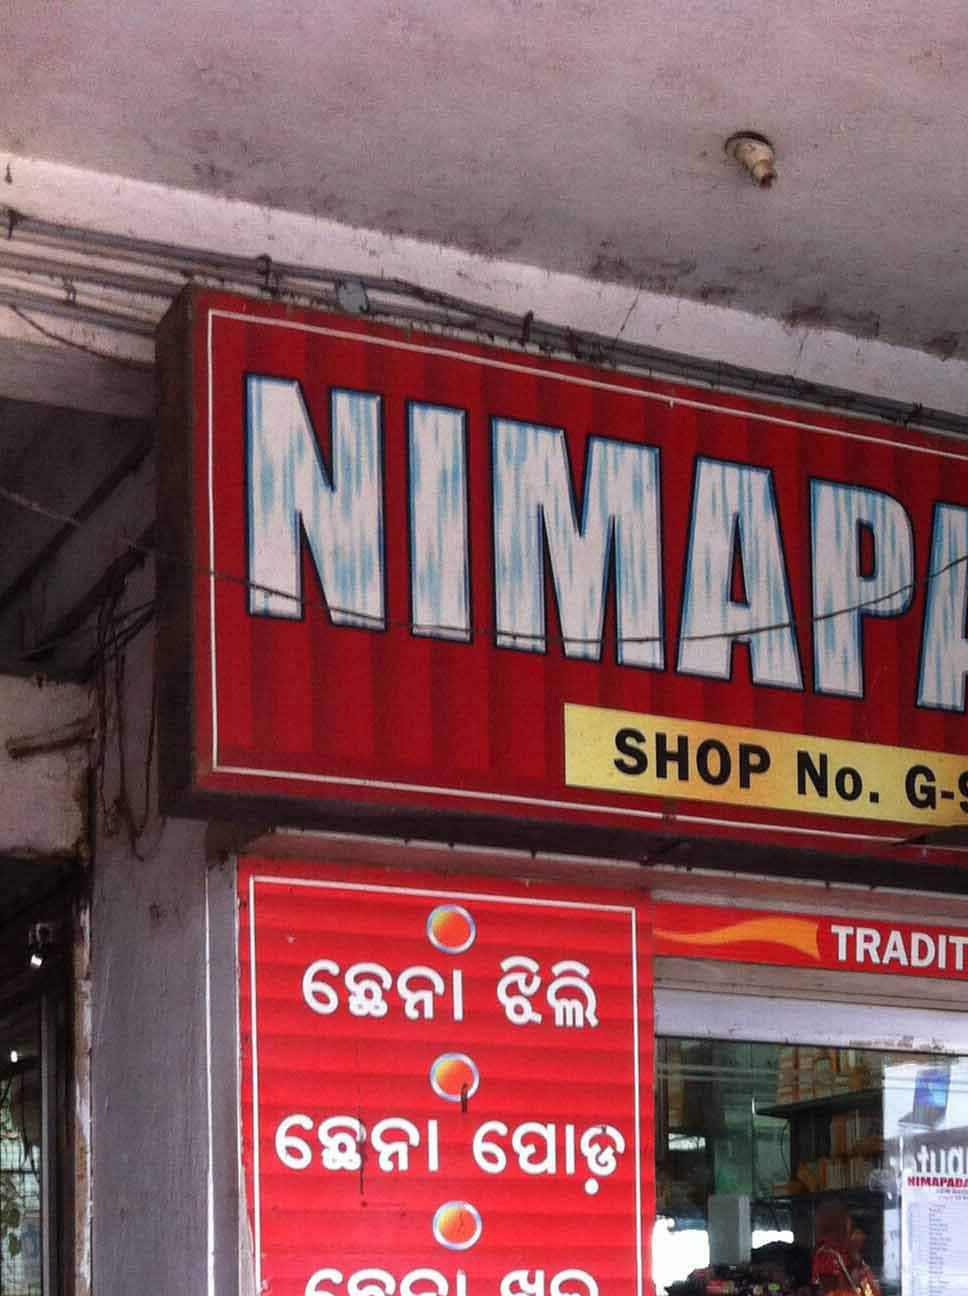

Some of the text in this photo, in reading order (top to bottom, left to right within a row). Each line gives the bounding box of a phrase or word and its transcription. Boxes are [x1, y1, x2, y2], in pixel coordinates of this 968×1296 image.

[613, 728, 771, 789] SHOP
[798, 750, 880, 804] No.
[302, 954, 600, 1028] ଛେନା ଝିଲି
[275, 1114, 627, 1197] ଛେନା ପୋଡ଼
